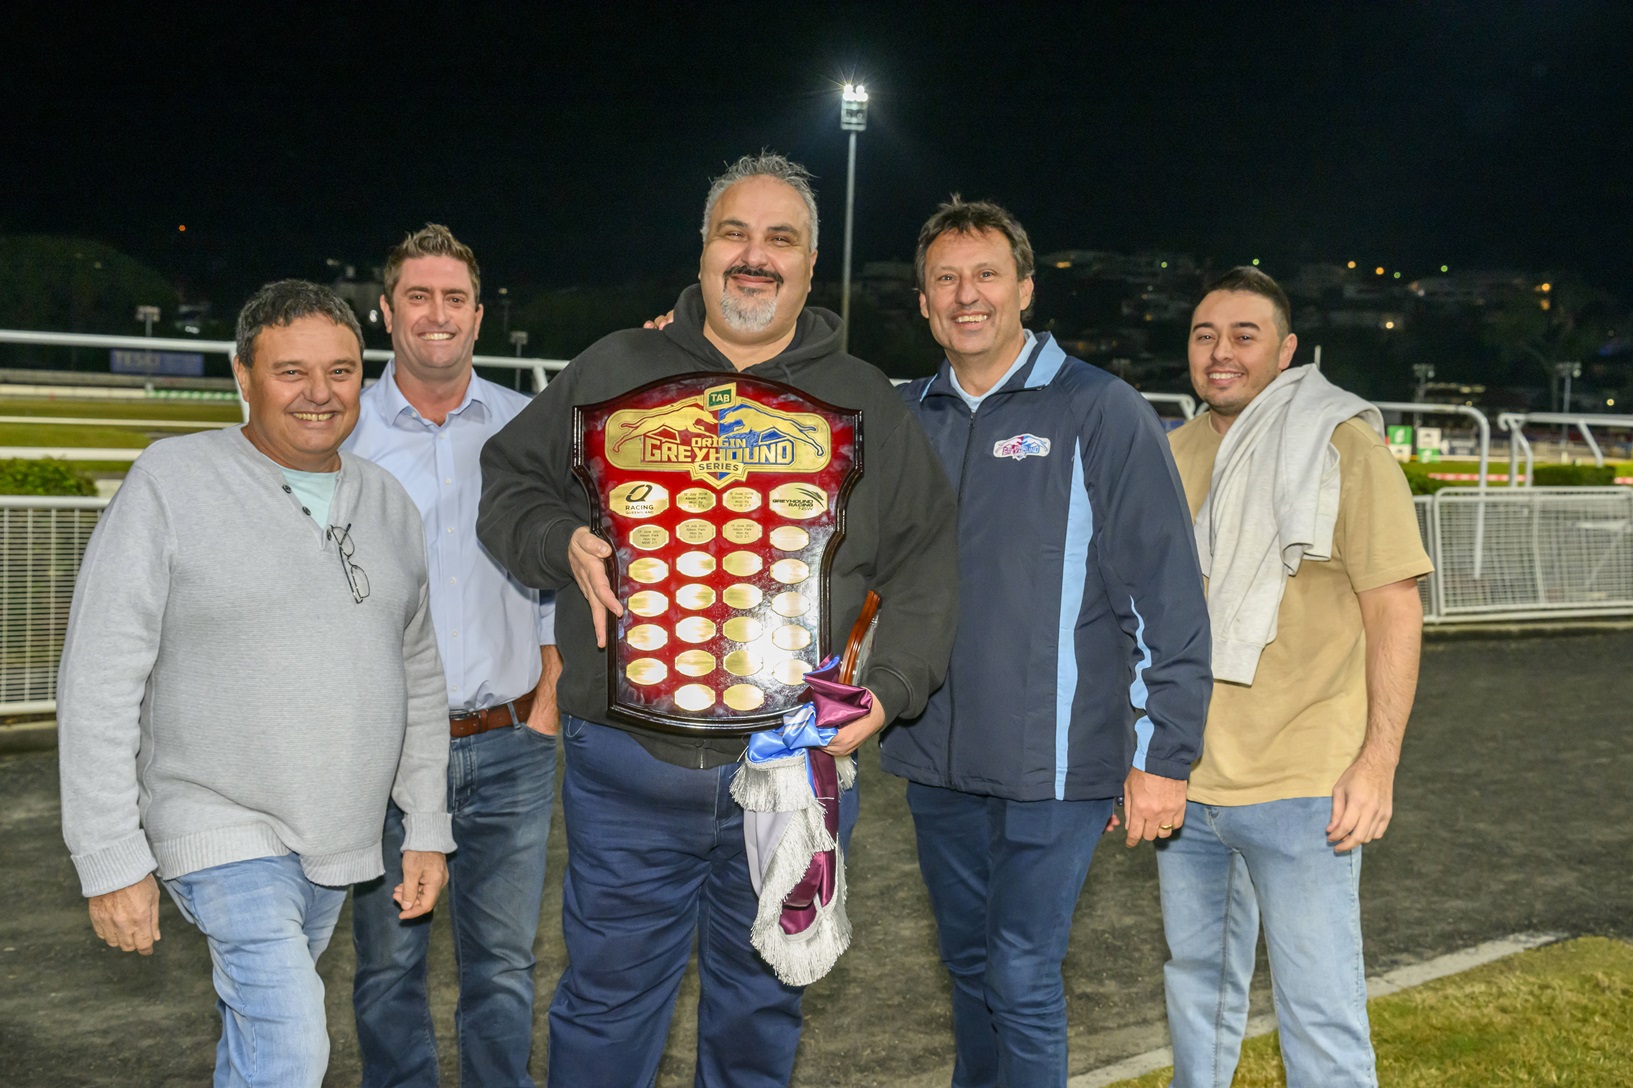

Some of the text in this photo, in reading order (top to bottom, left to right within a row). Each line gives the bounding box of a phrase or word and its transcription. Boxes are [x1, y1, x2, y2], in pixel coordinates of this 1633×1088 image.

[711, 393, 730, 402] TAB
[691, 437, 746, 447] ORIGIN
[644, 436, 793, 464] GREYHOUND
[698, 462, 740, 472] SERIES
